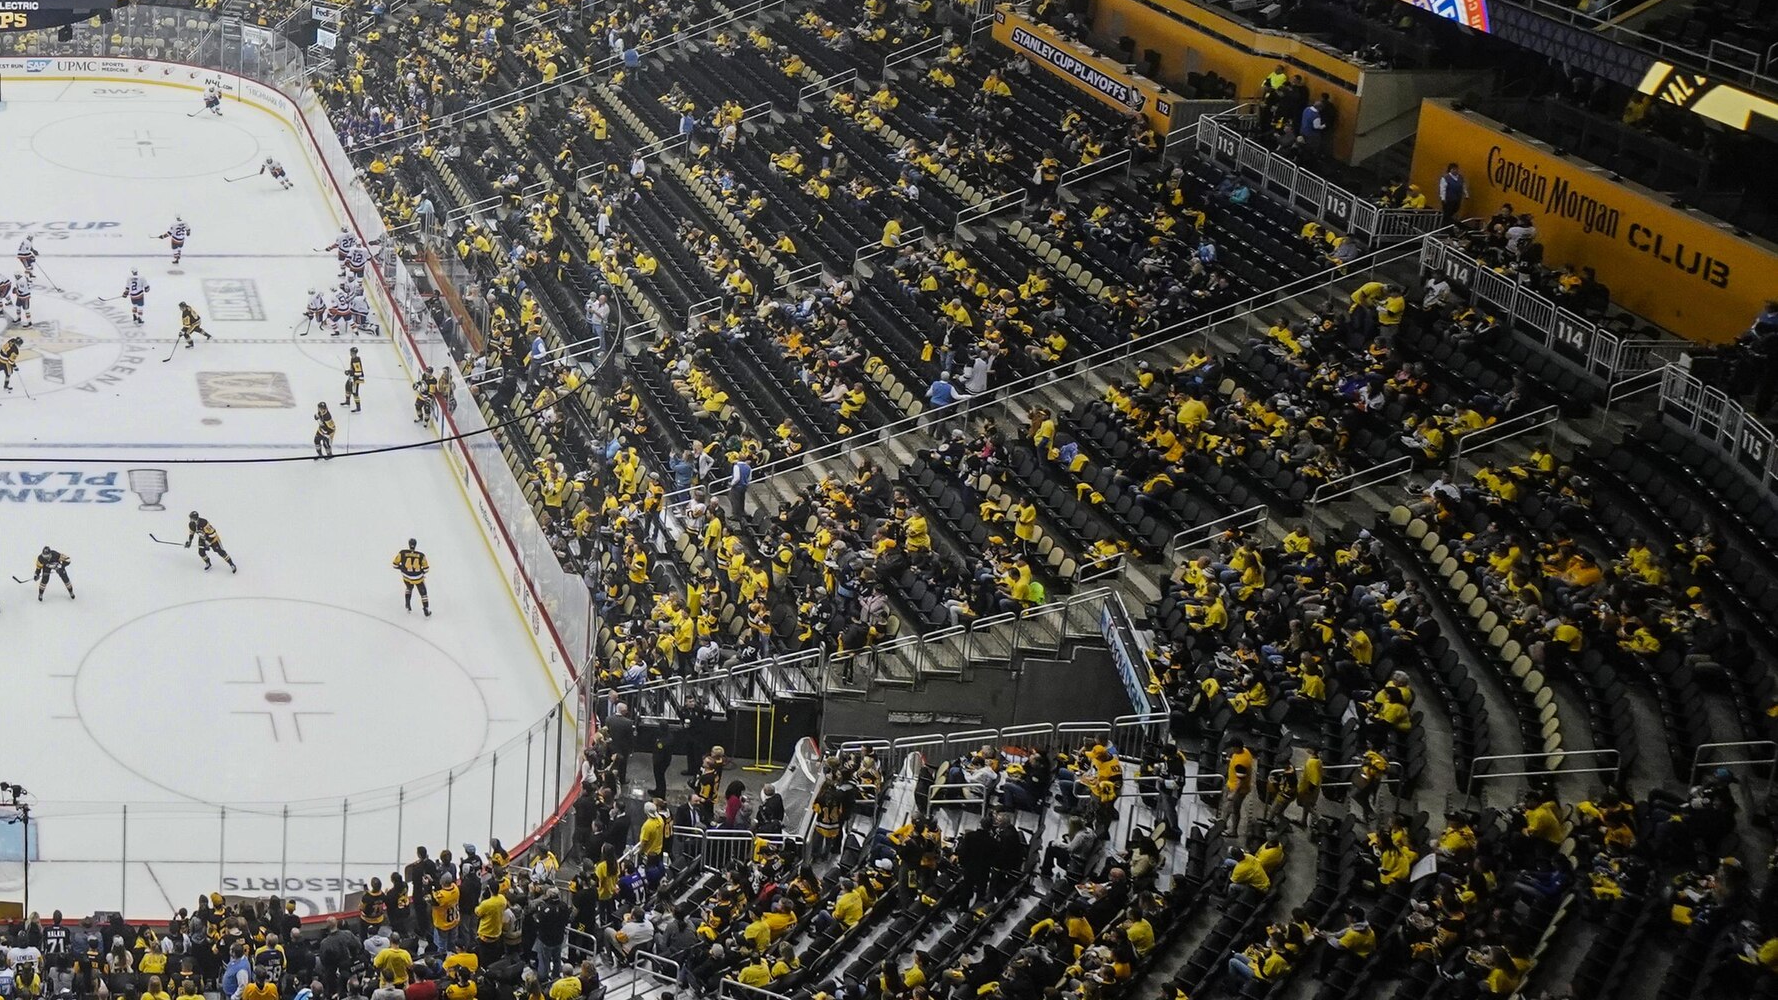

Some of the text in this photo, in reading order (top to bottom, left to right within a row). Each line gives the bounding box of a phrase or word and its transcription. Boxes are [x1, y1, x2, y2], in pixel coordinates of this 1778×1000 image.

[995, 12, 1005, 24] 112
[27, 60, 47, 72] SAP
[57, 60, 97, 72] UPMC
[1013, 29, 1127, 101] STANLEY CUP PLAYOFFS
[93, 87, 144, 96] aws
[1158, 102, 1169, 115] 112
[1217, 135, 1235, 157] 113
[1326, 194, 1348, 218] 113
[1487, 145, 1731, 290] Captain Morgan CLUB
[44, 221, 121, 231] CUP
[1444, 259, 1469, 284] 114
[1556, 322, 1583, 349] 114
[1740, 426, 1764, 461] 115
[404, 557, 421, 573] 44
[223, 876, 366, 892] RESORTS
[47, 938, 65, 953] 71
